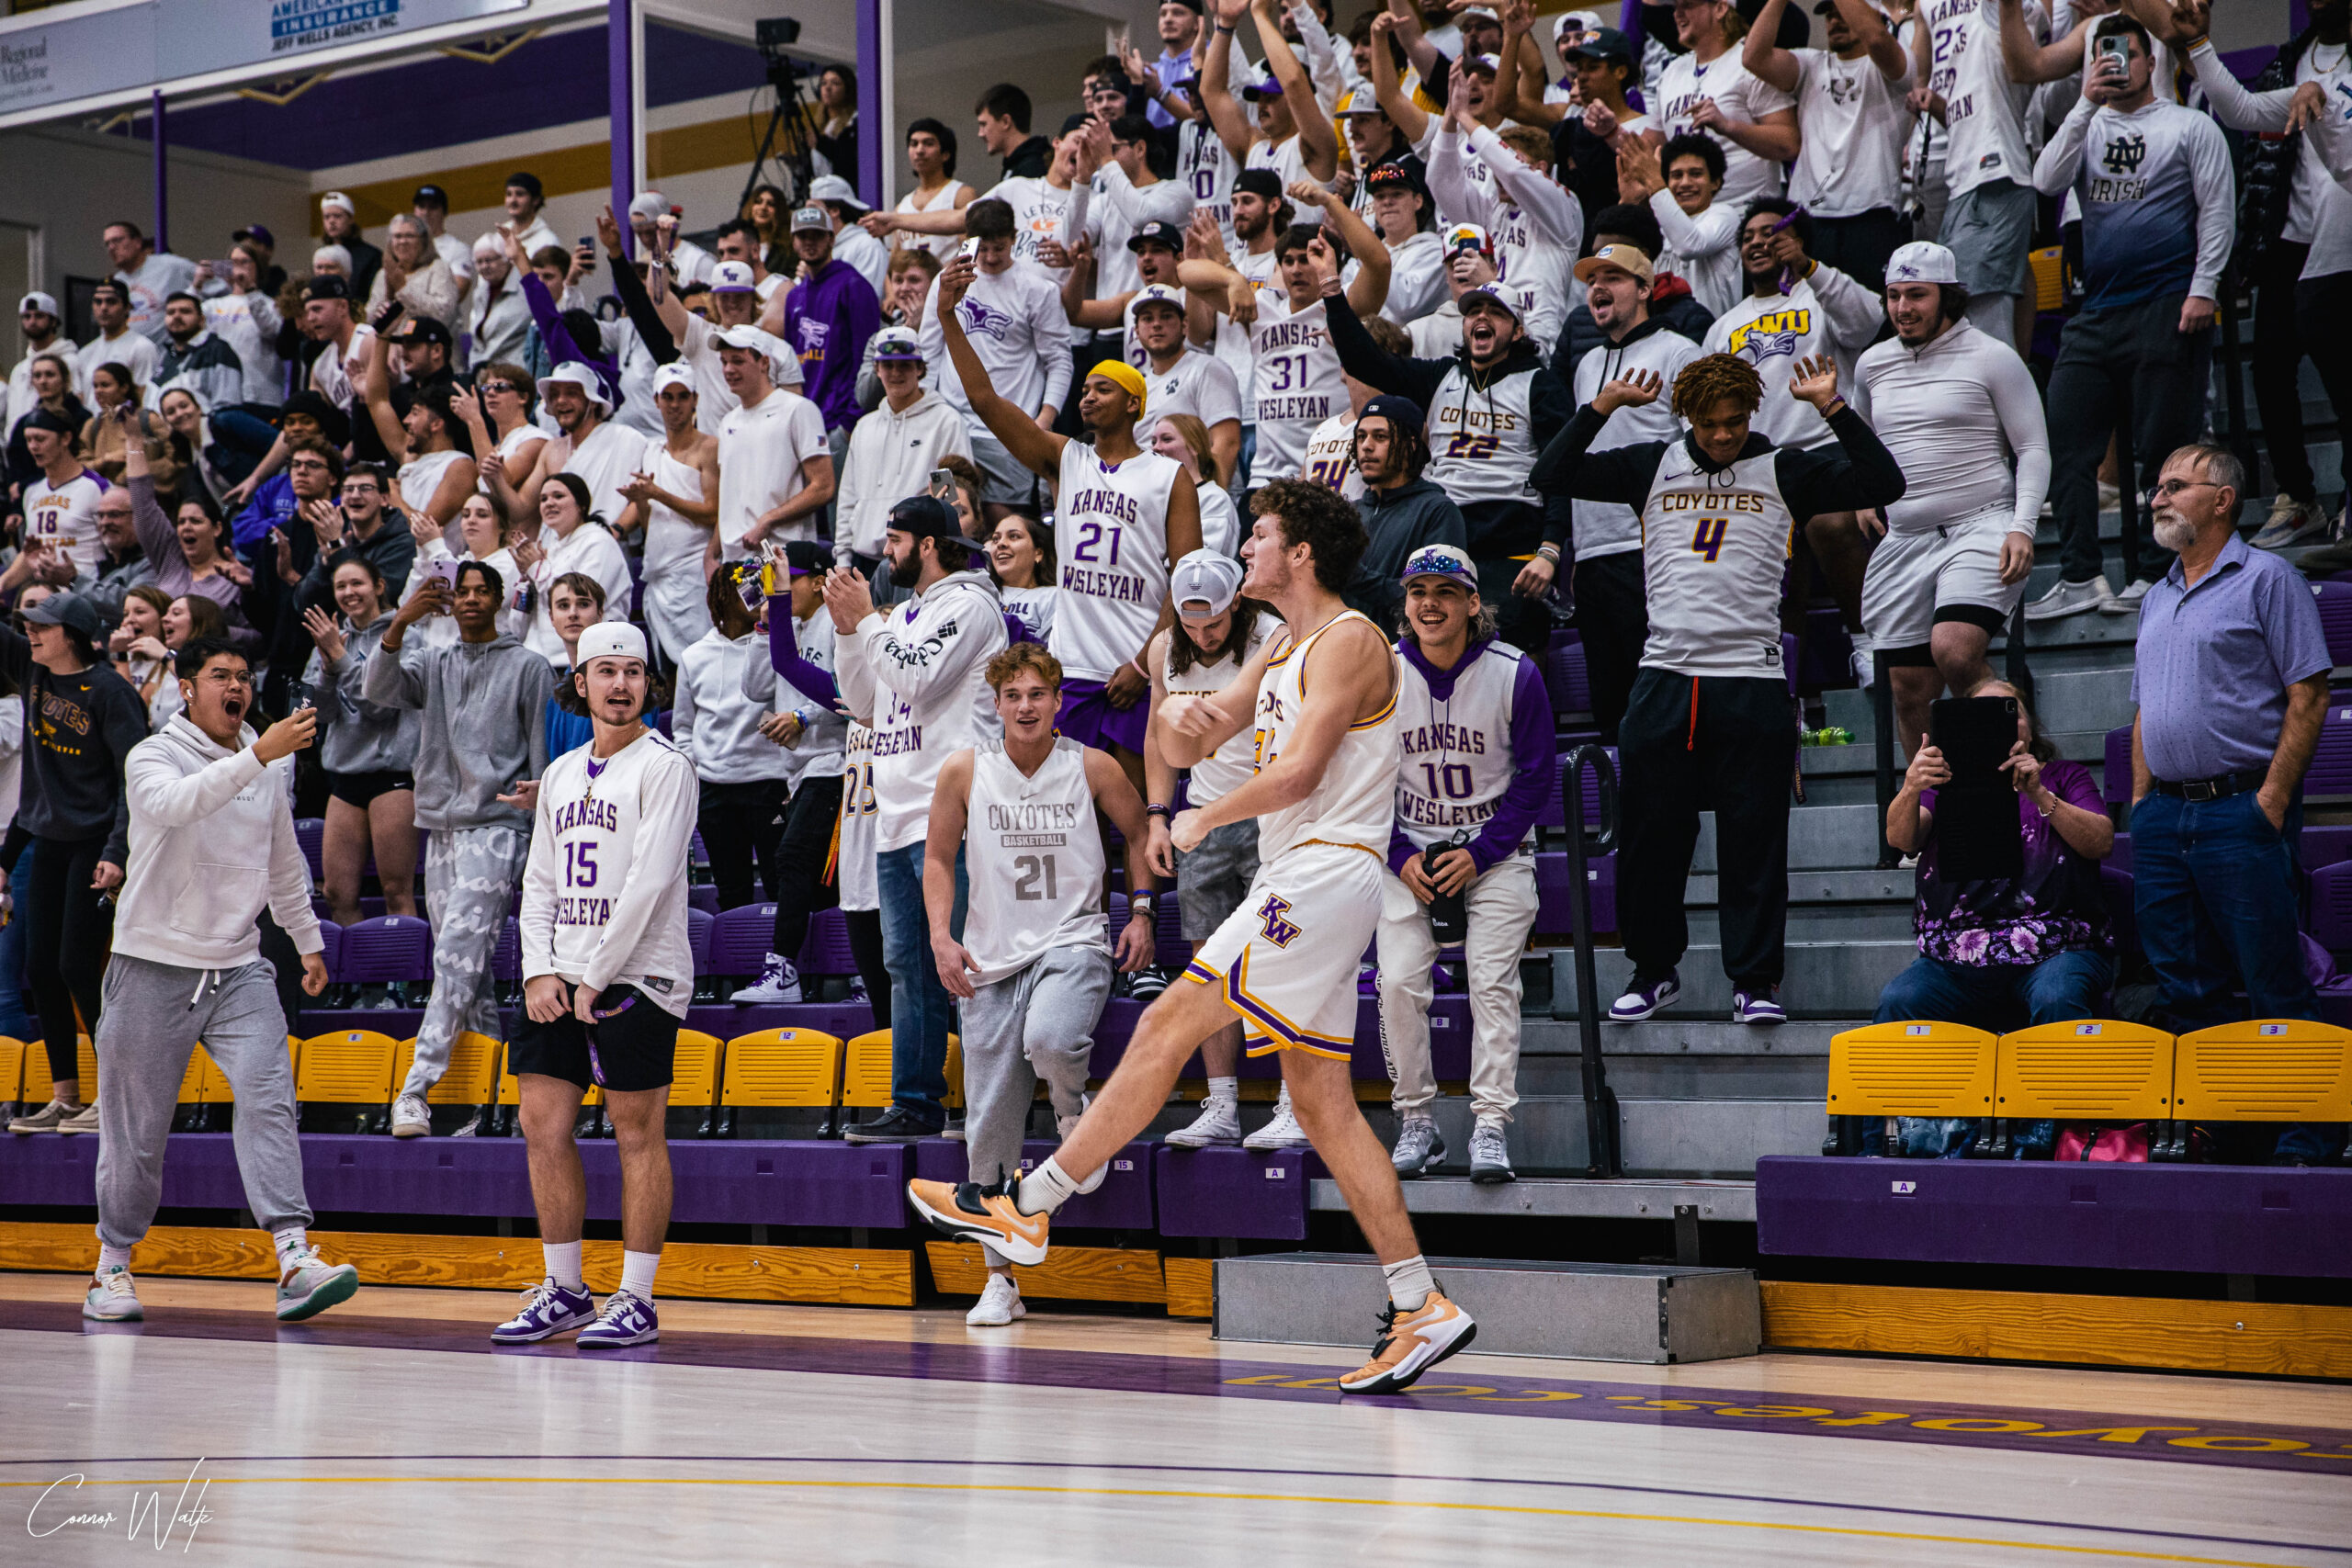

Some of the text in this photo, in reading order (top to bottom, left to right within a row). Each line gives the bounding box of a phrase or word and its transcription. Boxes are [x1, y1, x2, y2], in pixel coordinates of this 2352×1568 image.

[281, 0, 388, 34] INSURANCE
[297, 28, 330, 45] WELLS
[2088, 177, 2147, 202] IRISH
[1261, 323, 1320, 355] KANSAS
[1728, 309, 1811, 356] KWU
[1272, 354, 1308, 391] 31
[1258, 396, 1329, 422] WESLEYAN
[1445, 430, 1500, 459] 22
[1070, 489, 1138, 525] KANSAS
[1662, 493, 1764, 513] COYOTES
[37, 511, 58, 535] 18
[1073, 522, 1123, 567] 21
[1690, 517, 1729, 563] 4
[1063, 565, 1146, 603] WSLEYAN
[1402, 723, 1486, 755] KANSAS
[1419, 762, 1475, 799] 10
[556, 798, 617, 837] KANSAS
[988, 802, 1077, 831] COYOTES
[1003, 835, 1064, 847] BASKETBALL
[563, 840, 598, 888] 15
[1014, 854, 1057, 900] 21
[1257, 893, 1302, 949] KW
[783, 1032, 792, 1040] 12
[1436, 1018, 1443, 1026] B
[1916, 1026, 1922, 1034] 1
[2085, 1025, 2094, 1034] 2
[2269, 1026, 2278, 1034] 3
[1272, 1169, 1278, 1178] A
[1900, 1183, 1908, 1191] A
